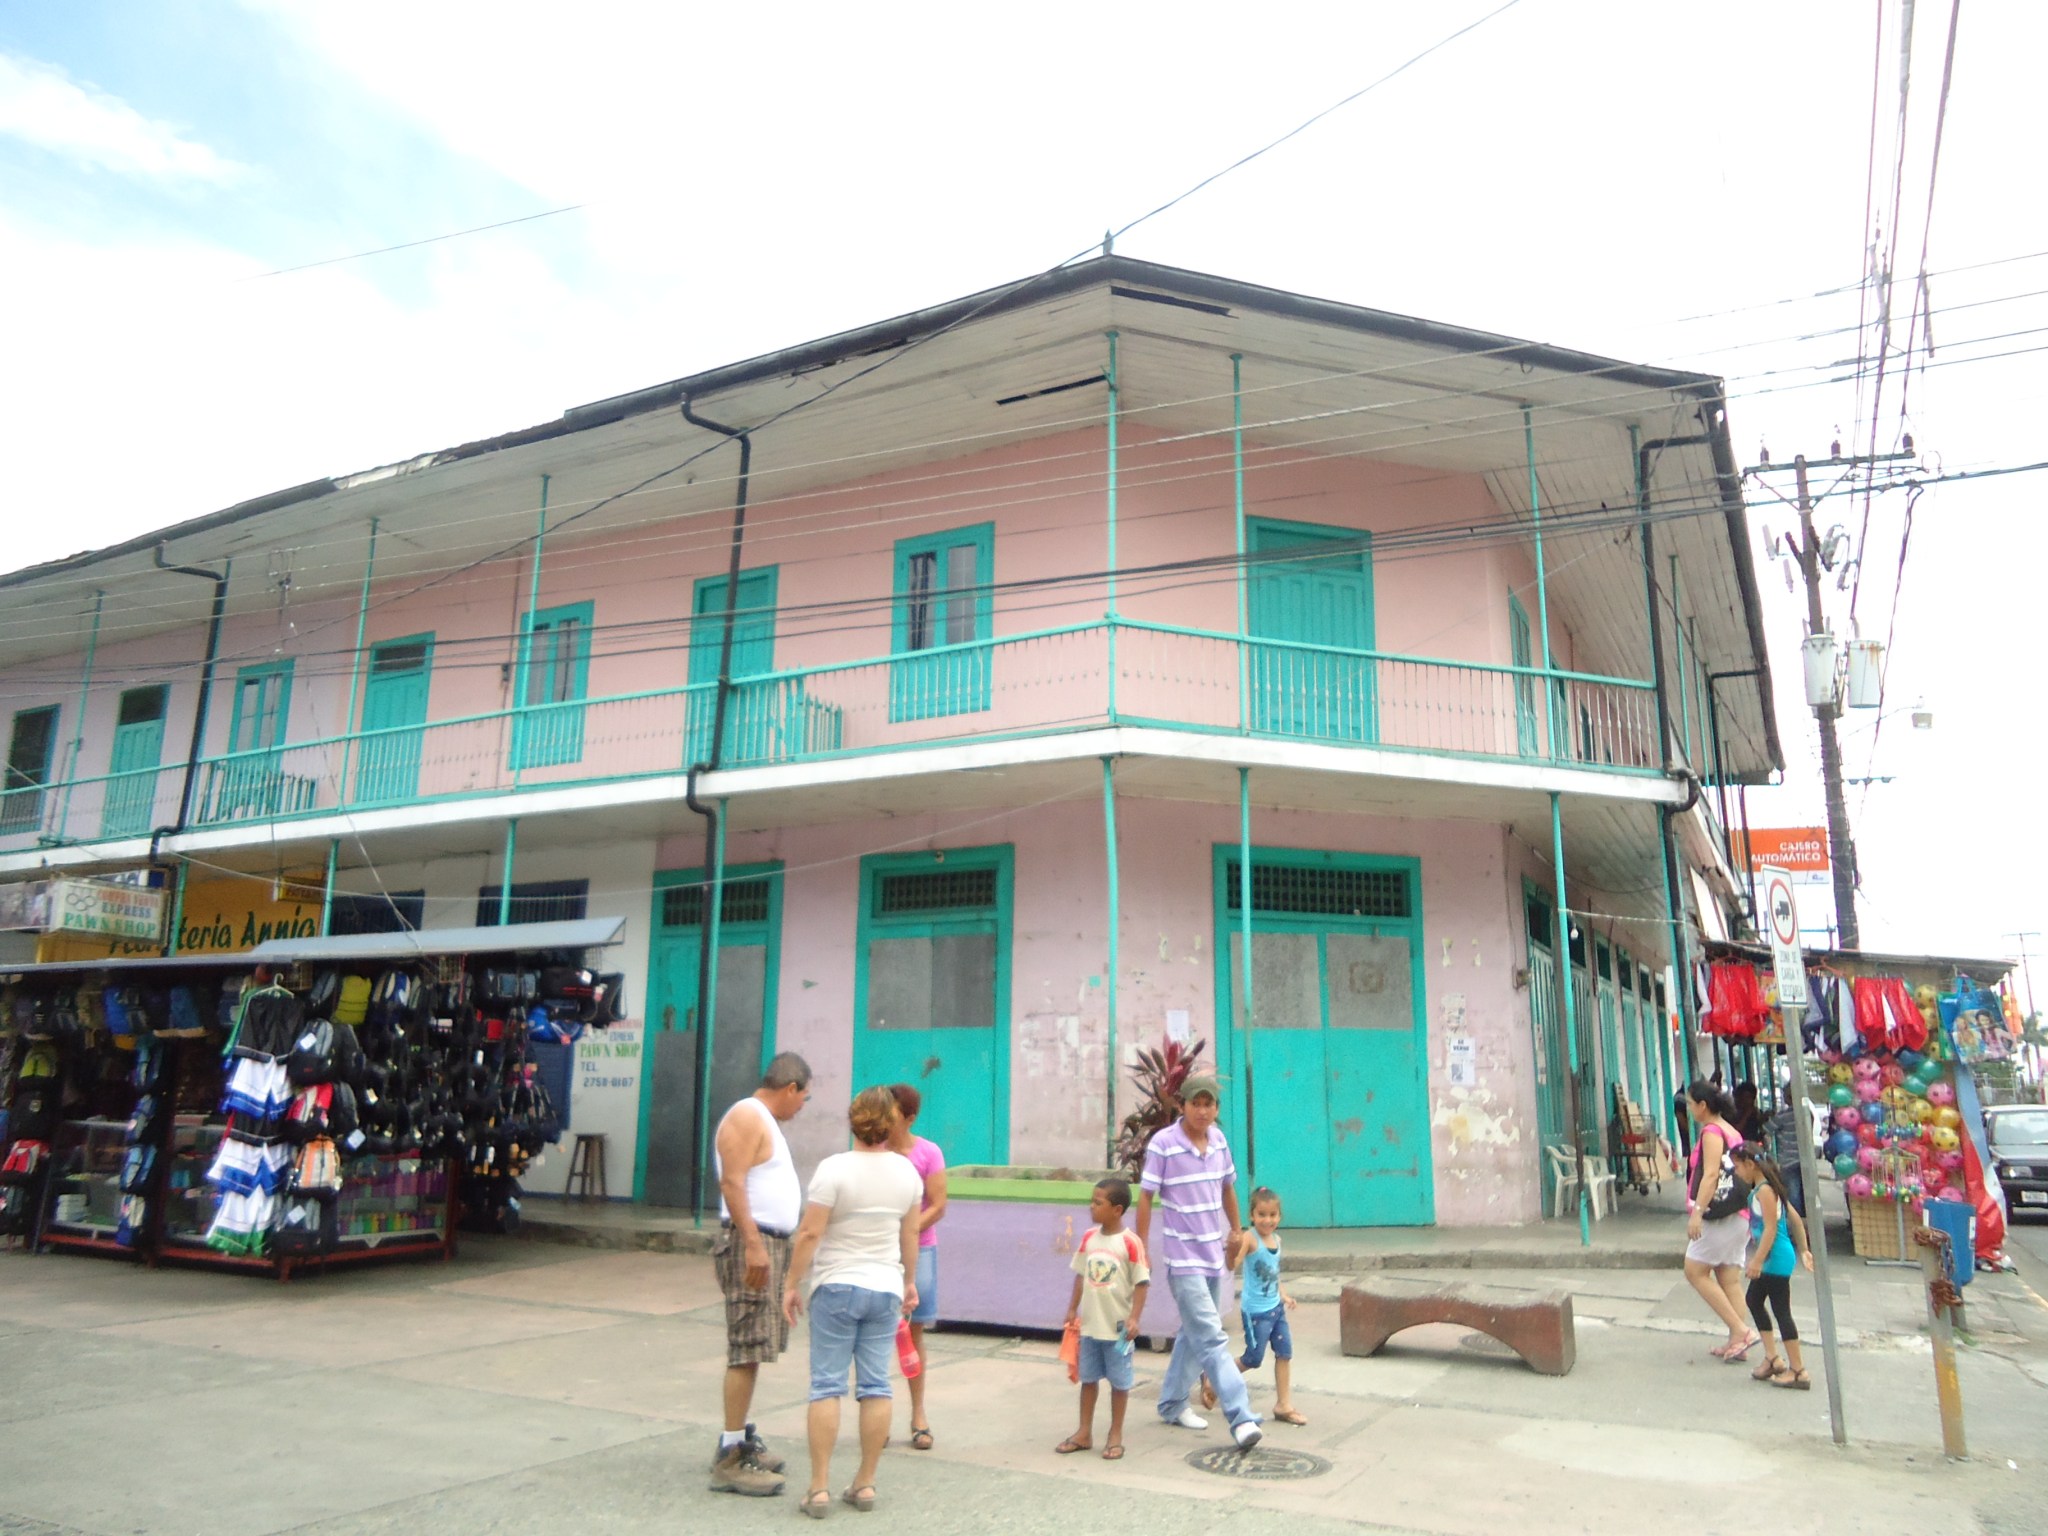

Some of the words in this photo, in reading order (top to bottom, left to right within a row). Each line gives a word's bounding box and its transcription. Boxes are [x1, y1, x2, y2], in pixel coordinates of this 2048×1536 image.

[1779, 841, 1820, 852] CAJERO
[1751, 852, 1821, 863] AUTOMÁTICO
[102, 902, 151, 918] EXPRESS
[64, 912, 110, 931] PAWN
[115, 919, 157, 936] SHOP
[581, 1043, 610, 1057] PAWN
[615, 1043, 640, 1057] SHOP
